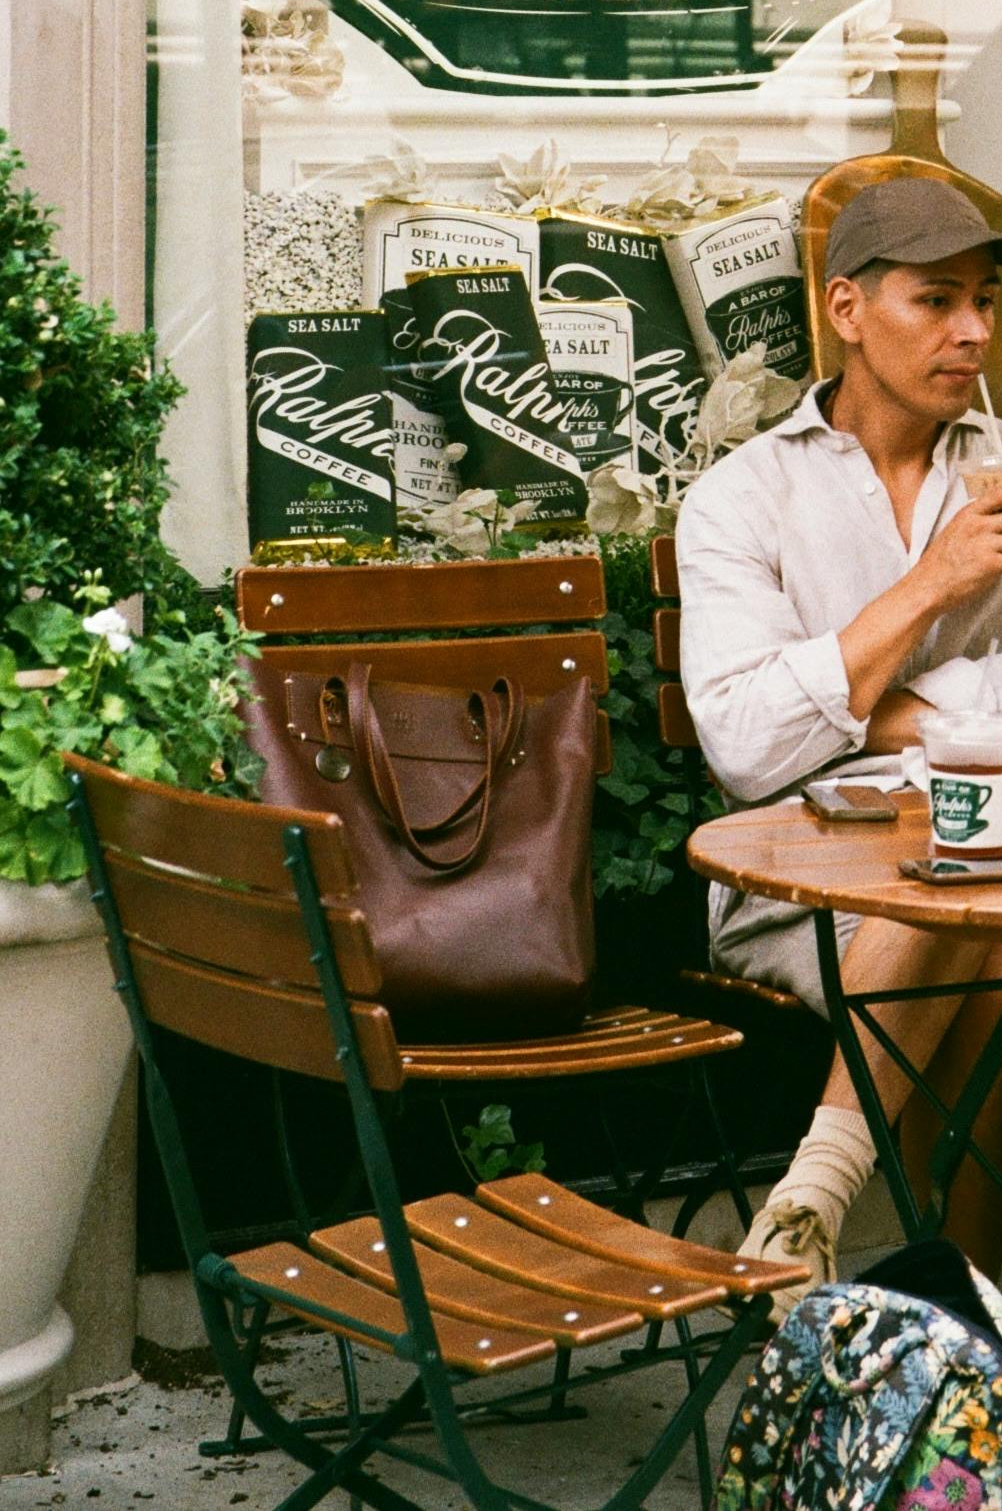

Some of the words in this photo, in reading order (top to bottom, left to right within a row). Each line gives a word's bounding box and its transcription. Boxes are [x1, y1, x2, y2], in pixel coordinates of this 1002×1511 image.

[411, 227, 505, 248] DELICIOUS
[587, 231, 617, 253] SEA
[620, 237, 658, 261] SALT
[706, 225, 772, 254] DELICIOUS
[411, 248, 449, 268] SEA
[713, 254, 743, 278] SEA
[746, 240, 782, 266] SALT
[456, 278, 478, 294] SEA
[481, 277, 511, 294] SALT
[728, 301, 739, 313] A
[740, 290, 768, 307] BAR
[769, 285, 786, 297] OF
[288, 319, 318, 333] SEA
[321, 318, 361, 332] SALT
[539, 322, 607, 331] ELICIOUS
[725, 305, 792, 351] Ralph's
[545, 339, 563, 355] EA
[567, 339, 610, 355] SALT
[584, 380, 604, 390] OF
[394, 420, 442, 435] HAND
[568, 421, 608, 431] FFEE
[389, 431, 446, 450] BROO
[490, 418, 568, 466] COFFEE
[280, 441, 373, 486] COFFEE
[411, 477, 432, 491] NET
